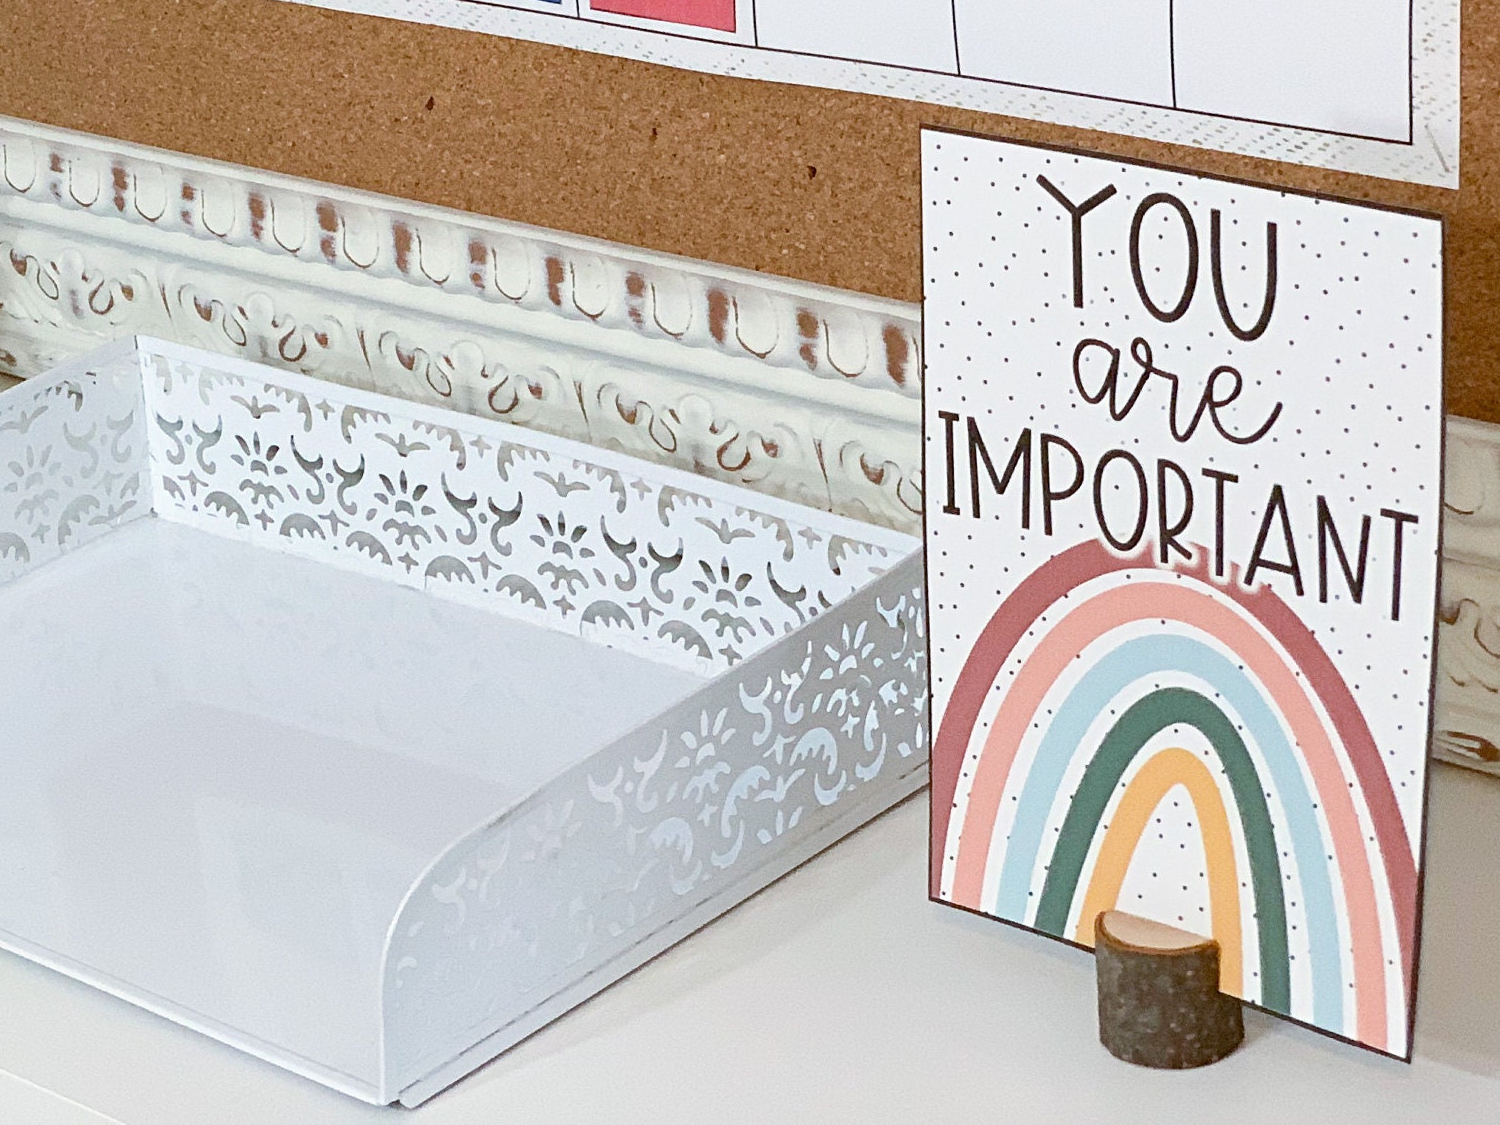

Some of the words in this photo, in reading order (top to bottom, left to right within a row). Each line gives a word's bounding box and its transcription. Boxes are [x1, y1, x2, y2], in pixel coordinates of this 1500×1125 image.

[1036, 174, 1277, 341] YOU
[1073, 337, 1282, 444] are
[938, 410, 1418, 621] IMPORTANT
